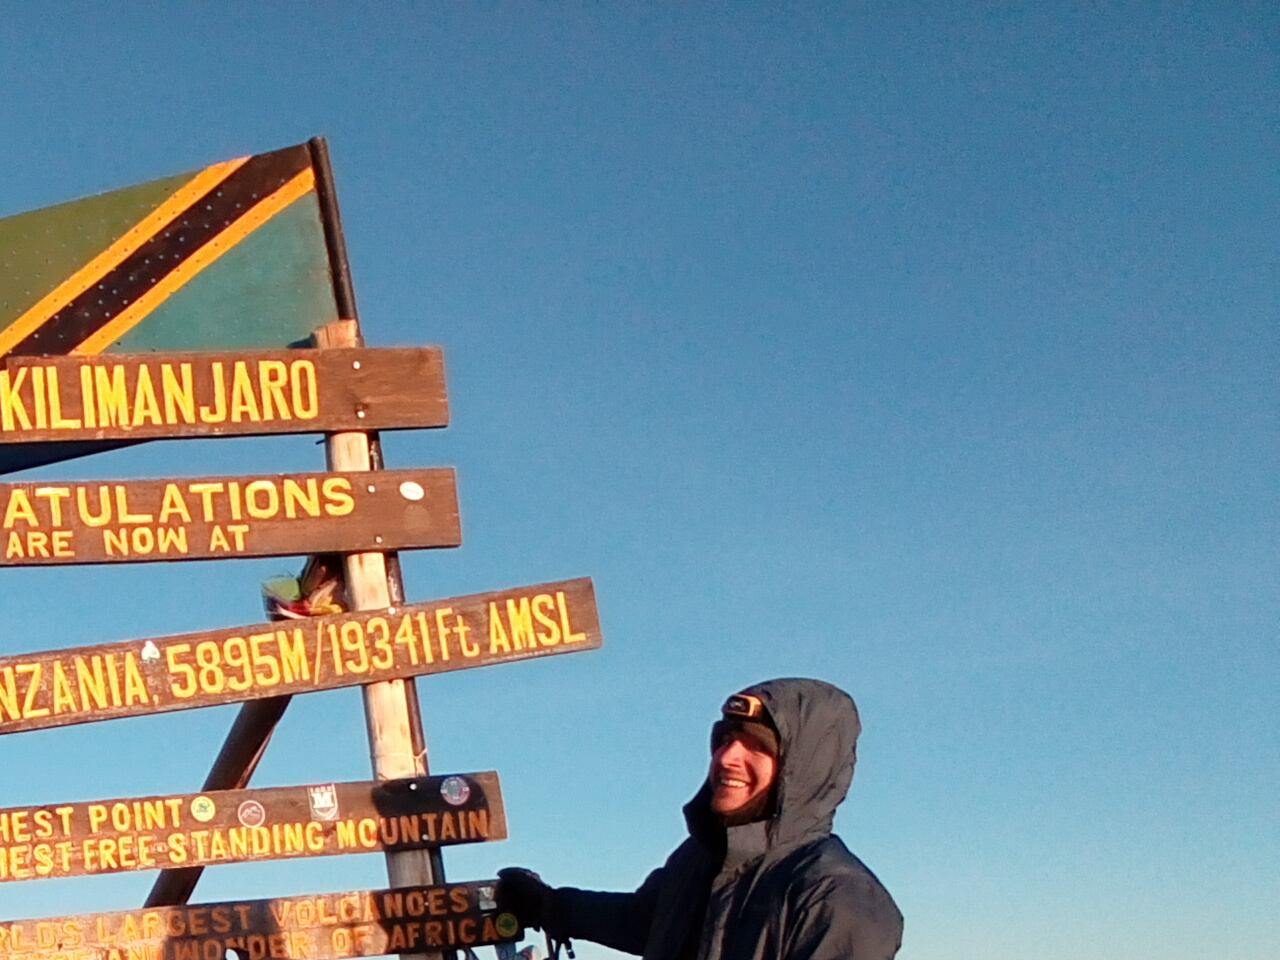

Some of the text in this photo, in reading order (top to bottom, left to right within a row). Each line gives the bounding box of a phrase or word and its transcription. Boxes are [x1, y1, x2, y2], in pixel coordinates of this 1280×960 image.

[6, 530, 76, 559] ARE
[103, 526, 188, 556] NOW
[209, 524, 250, 552] AT
[488, 591, 587, 654] AMSL
[88, 798, 183, 833] POINT
[336, 809, 490, 849] MOUNTAIN
[96, 904, 251, 943] LARGEST
[270, 886, 469, 927] VOLCANOES
[332, 927, 372, 954] OF
[388, 917, 500, 950] AFRICA
